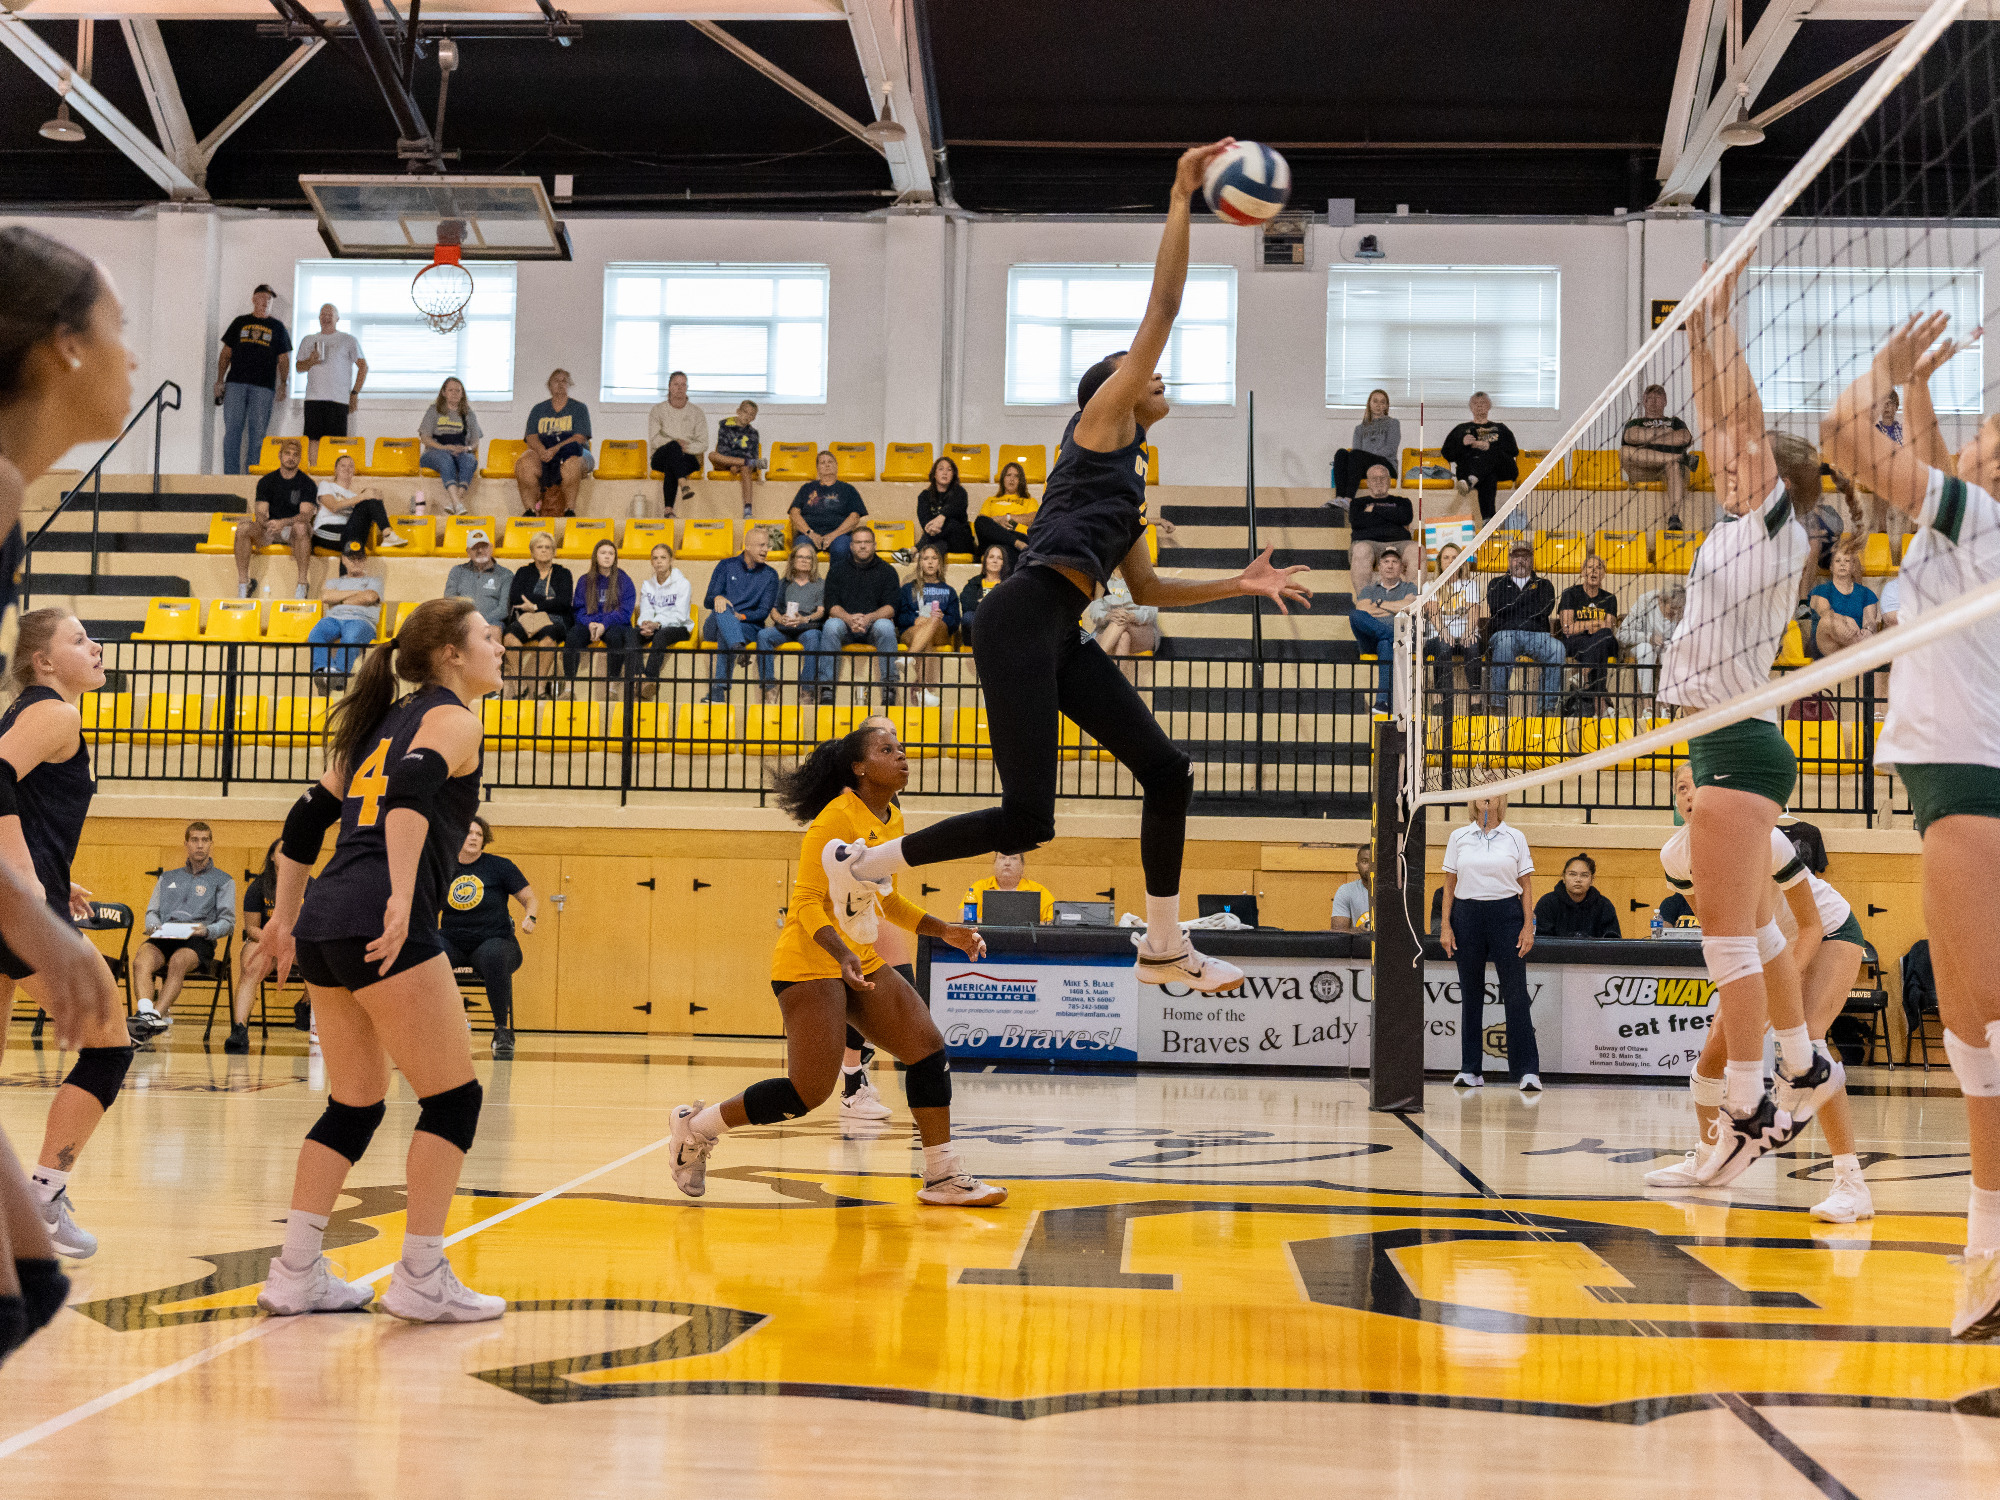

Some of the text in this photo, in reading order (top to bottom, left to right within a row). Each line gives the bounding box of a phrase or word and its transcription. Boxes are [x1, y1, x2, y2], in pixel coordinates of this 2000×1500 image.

[347, 736, 393, 826] 4
[947, 983, 1037, 993] AMERICAN FAMILY
[953, 993, 1030, 1001] INSURANCE
[1594, 976, 1719, 1009] SUBWAY
[1162, 1007, 1246, 1022] Home of the
[1618, 1013, 1716, 1038] eat fres
[943, 1023, 1123, 1051] Go Braves!
[1160, 1029, 1250, 1054] Braves
[1258, 1027, 1283, 1051] &
[1291, 1016, 1359, 1048] Lady
[1594, 1045, 1619, 1053] Subway
